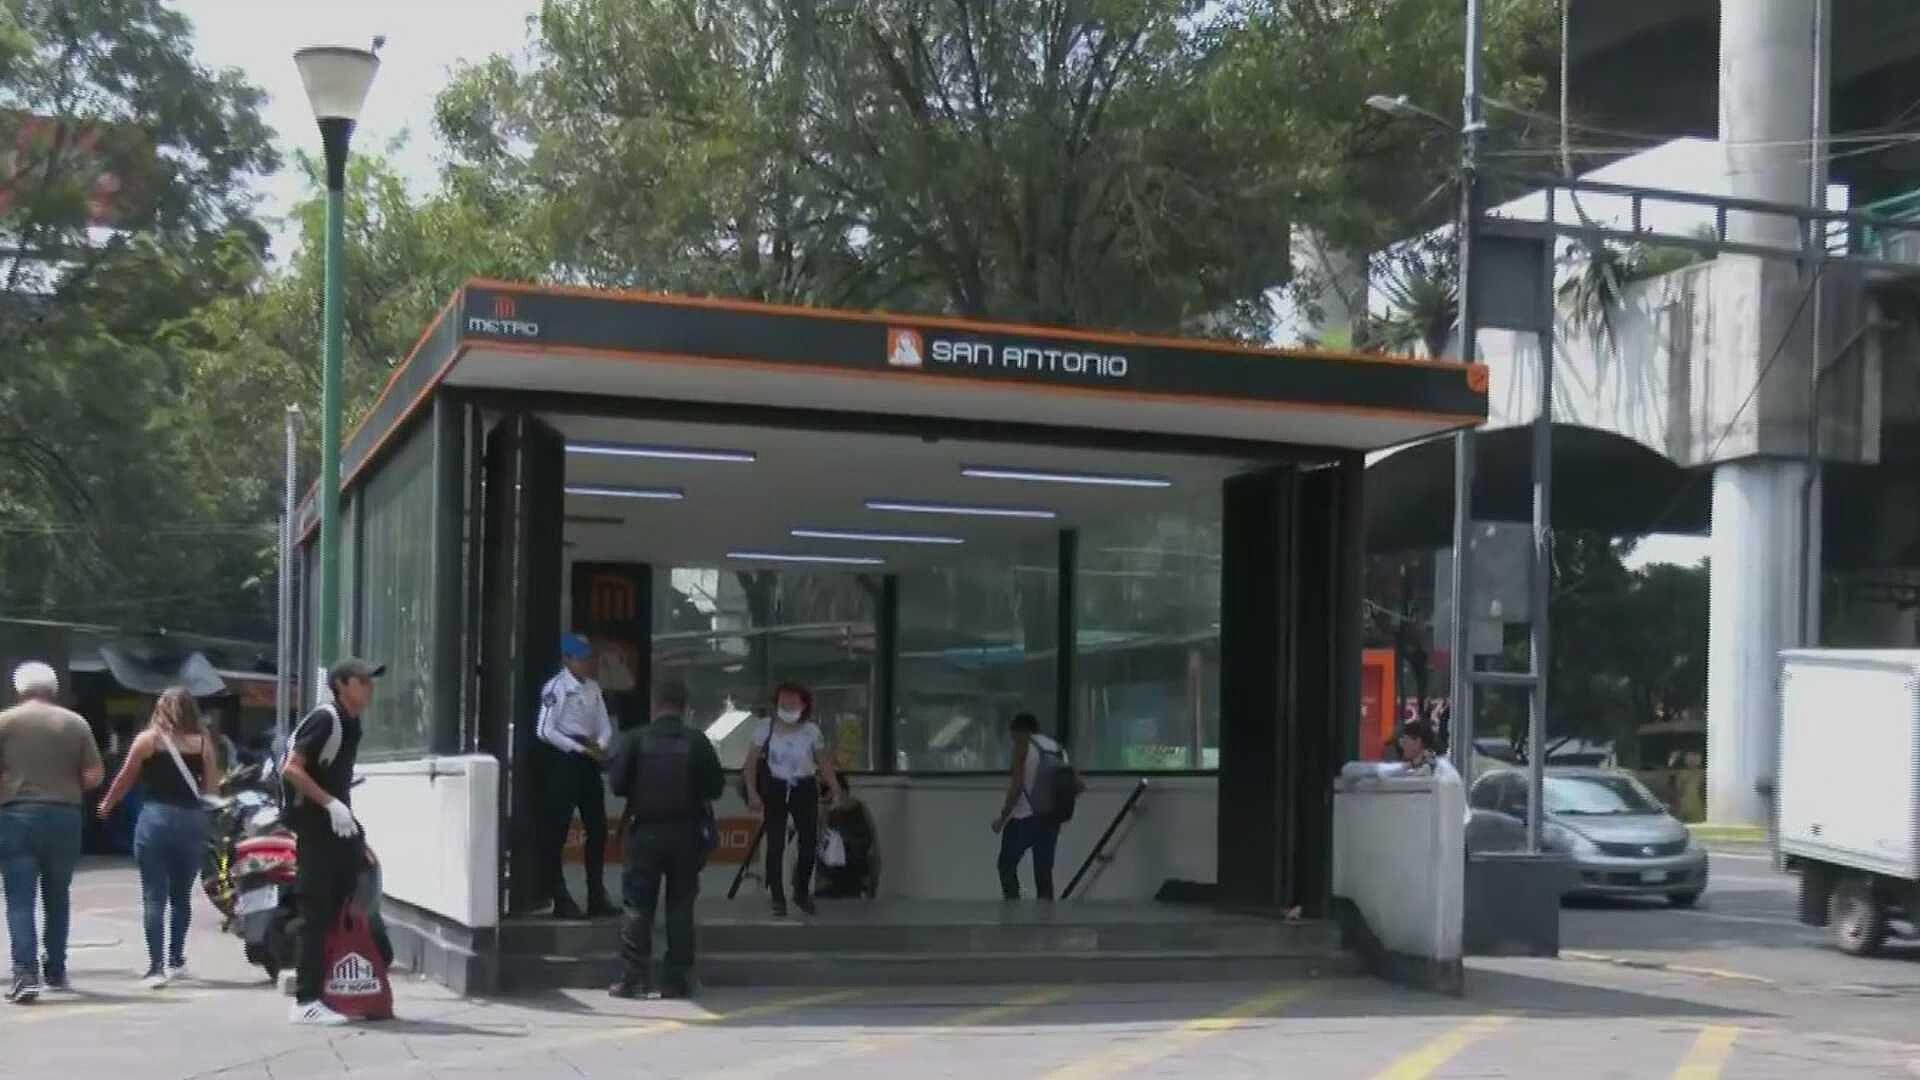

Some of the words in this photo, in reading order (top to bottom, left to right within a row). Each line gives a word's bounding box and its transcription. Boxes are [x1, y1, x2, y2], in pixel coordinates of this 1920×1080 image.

[469, 318, 538, 336] METRO
[932, 341, 993, 366] SAN
[1002, 348, 1128, 377] ANTONIO
